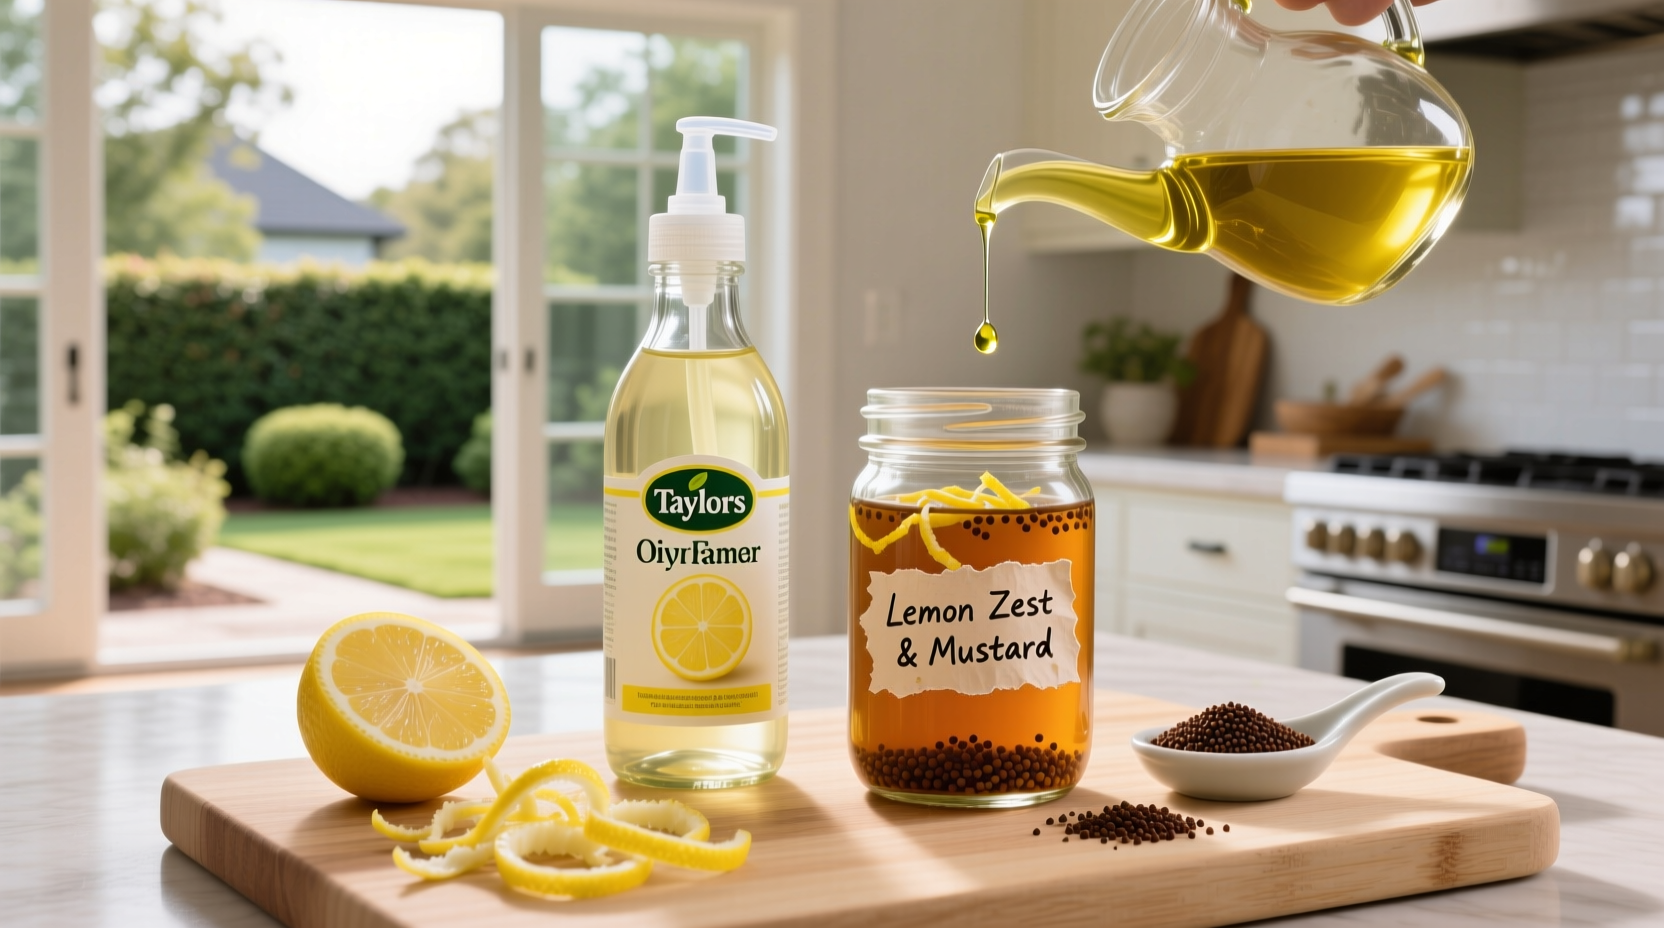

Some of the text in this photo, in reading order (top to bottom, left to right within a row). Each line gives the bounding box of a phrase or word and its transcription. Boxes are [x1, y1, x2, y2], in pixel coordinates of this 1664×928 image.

[653, 488, 746, 522] Taylors
[886, 589, 1053, 627] Lemon Zest
[897, 626, 1054, 668] & Mustard
